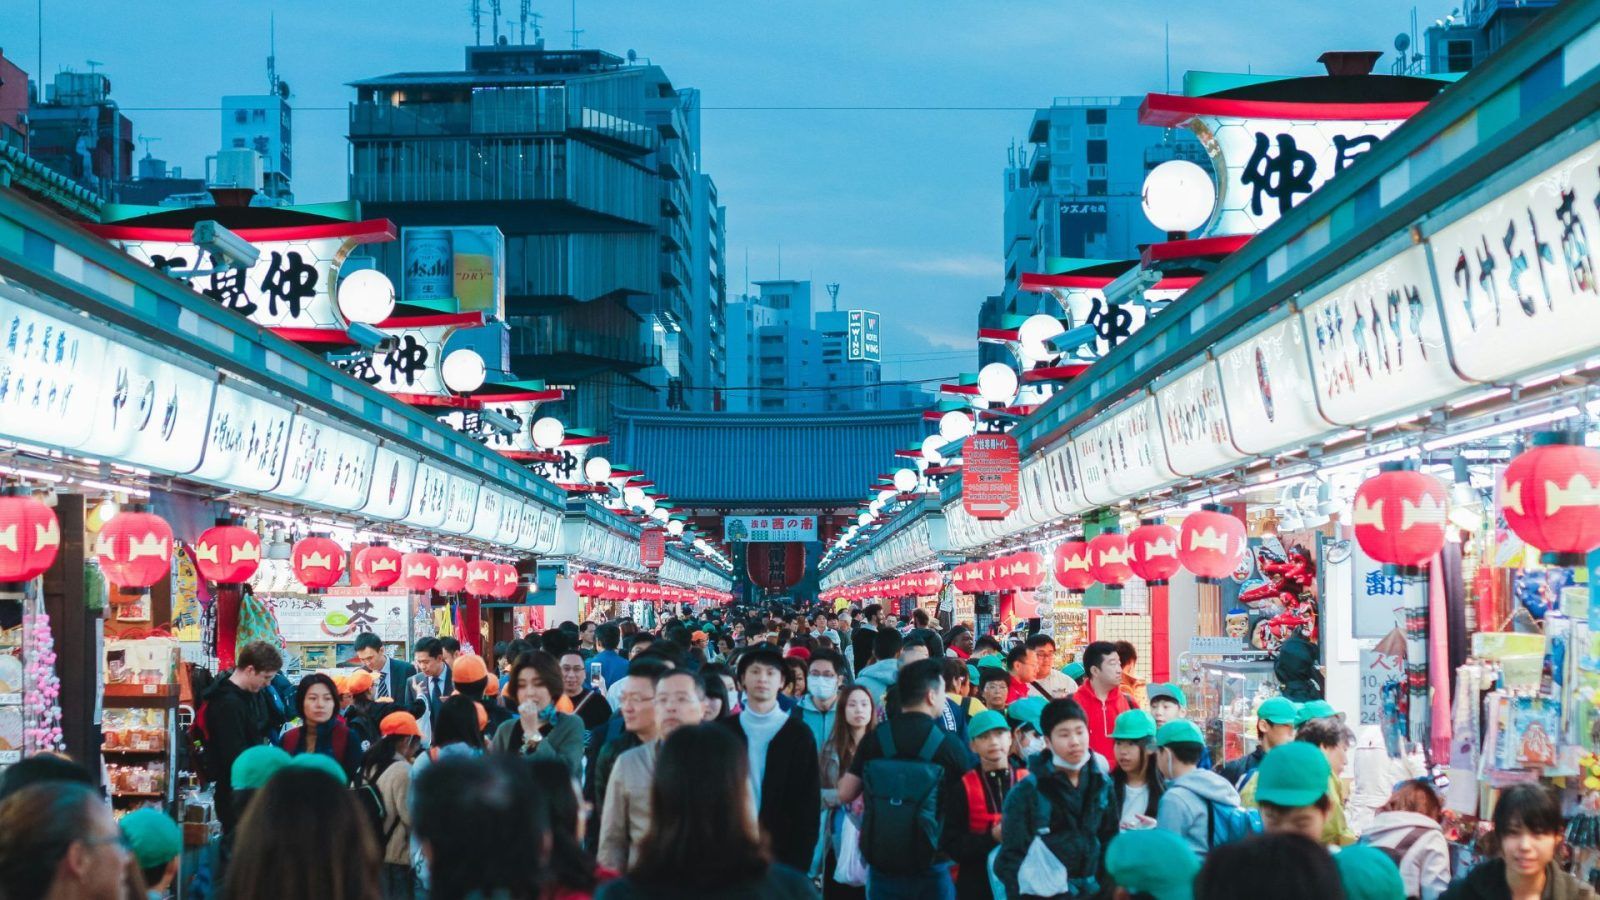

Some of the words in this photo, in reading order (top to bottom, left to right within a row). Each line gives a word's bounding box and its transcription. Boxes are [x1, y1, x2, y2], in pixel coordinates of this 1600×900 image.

[407, 258, 450, 277] Asahi
[851, 328, 861, 356] WING
[865, 343, 879, 354] WING
[346, 598, 378, 633] 茶
[1361, 675, 1377, 688] 10
[1361, 694, 1377, 705] 12
[1361, 712, 1376, 724] 24
